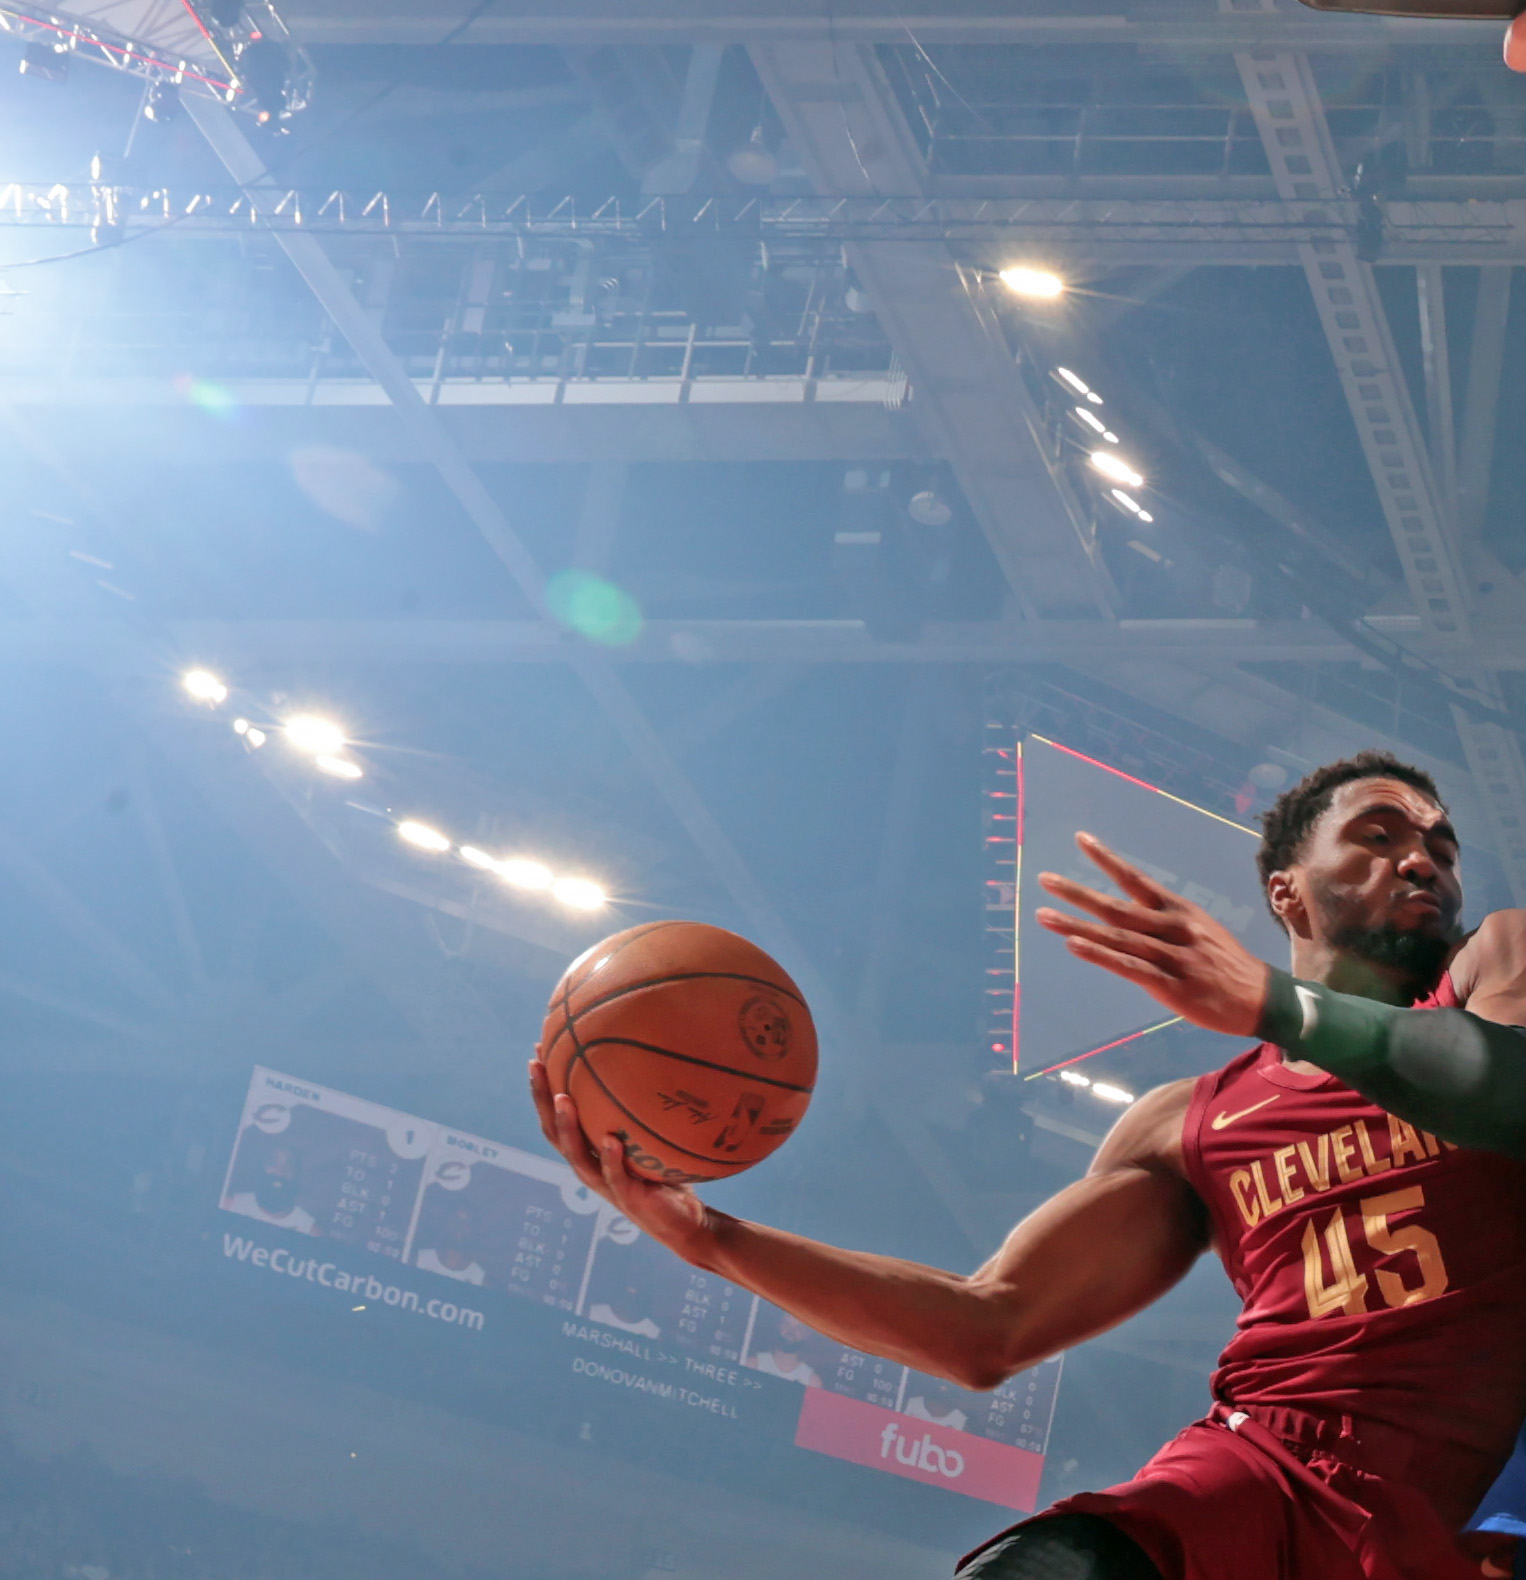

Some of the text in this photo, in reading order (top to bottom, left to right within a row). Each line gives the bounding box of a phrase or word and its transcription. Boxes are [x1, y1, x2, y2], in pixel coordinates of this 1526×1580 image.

[265, 1077, 320, 1102] HARDEN
[1229, 1113, 1459, 1227] CLEVELA
[222, 1233, 486, 1331] WeCutCarbon.com
[1301, 1185, 1448, 1319] 45
[562, 1321, 736, 1385] MARSHALL THREE
[880, 1423, 965, 1479] fubo
